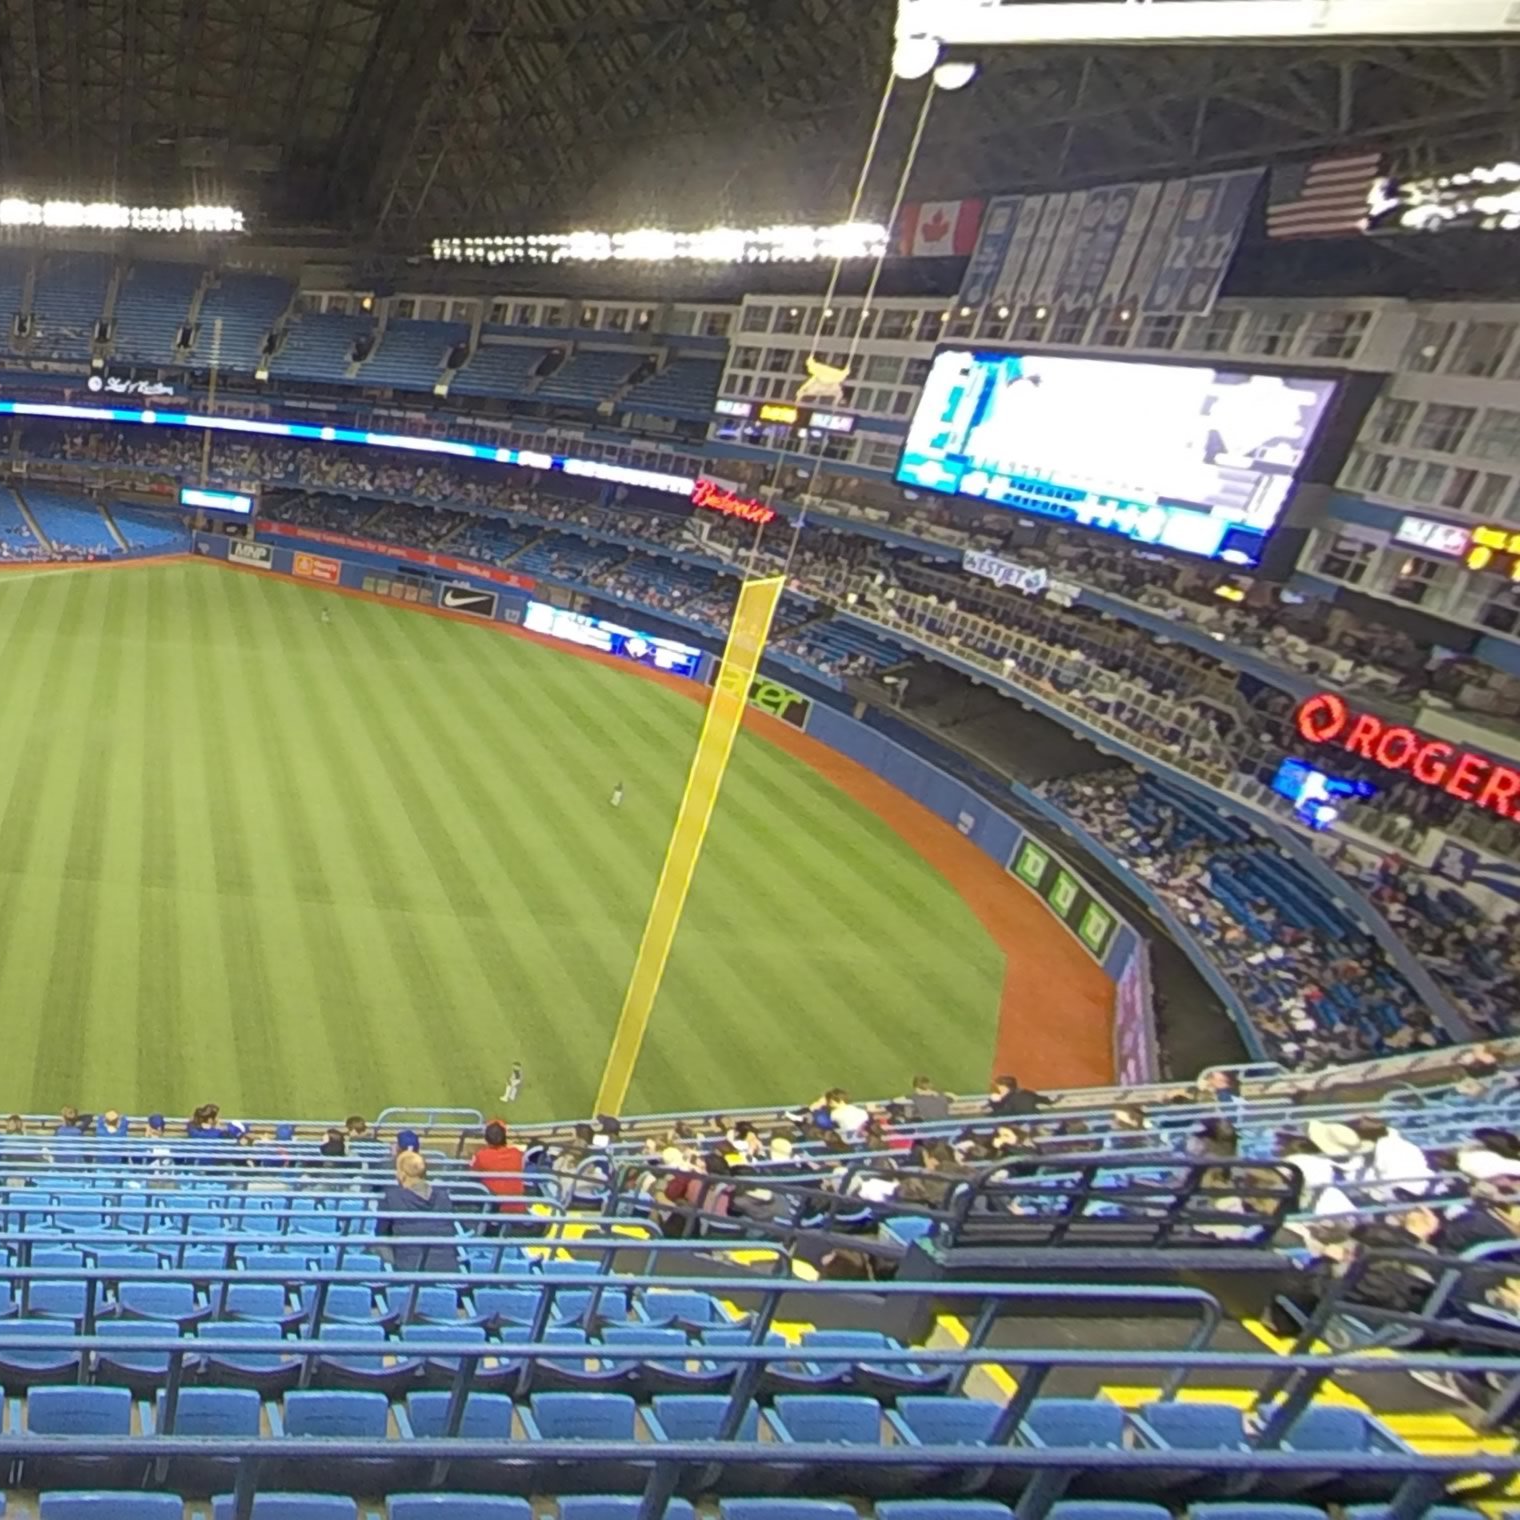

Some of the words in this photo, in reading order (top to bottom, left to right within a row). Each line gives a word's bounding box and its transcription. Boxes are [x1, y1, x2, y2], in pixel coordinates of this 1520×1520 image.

[692, 479, 775, 523] Budweiser
[236, 543, 266, 560] MNP
[964, 553, 1026, 584] WESTJET
[1345, 715, 1520, 822] ROGER
